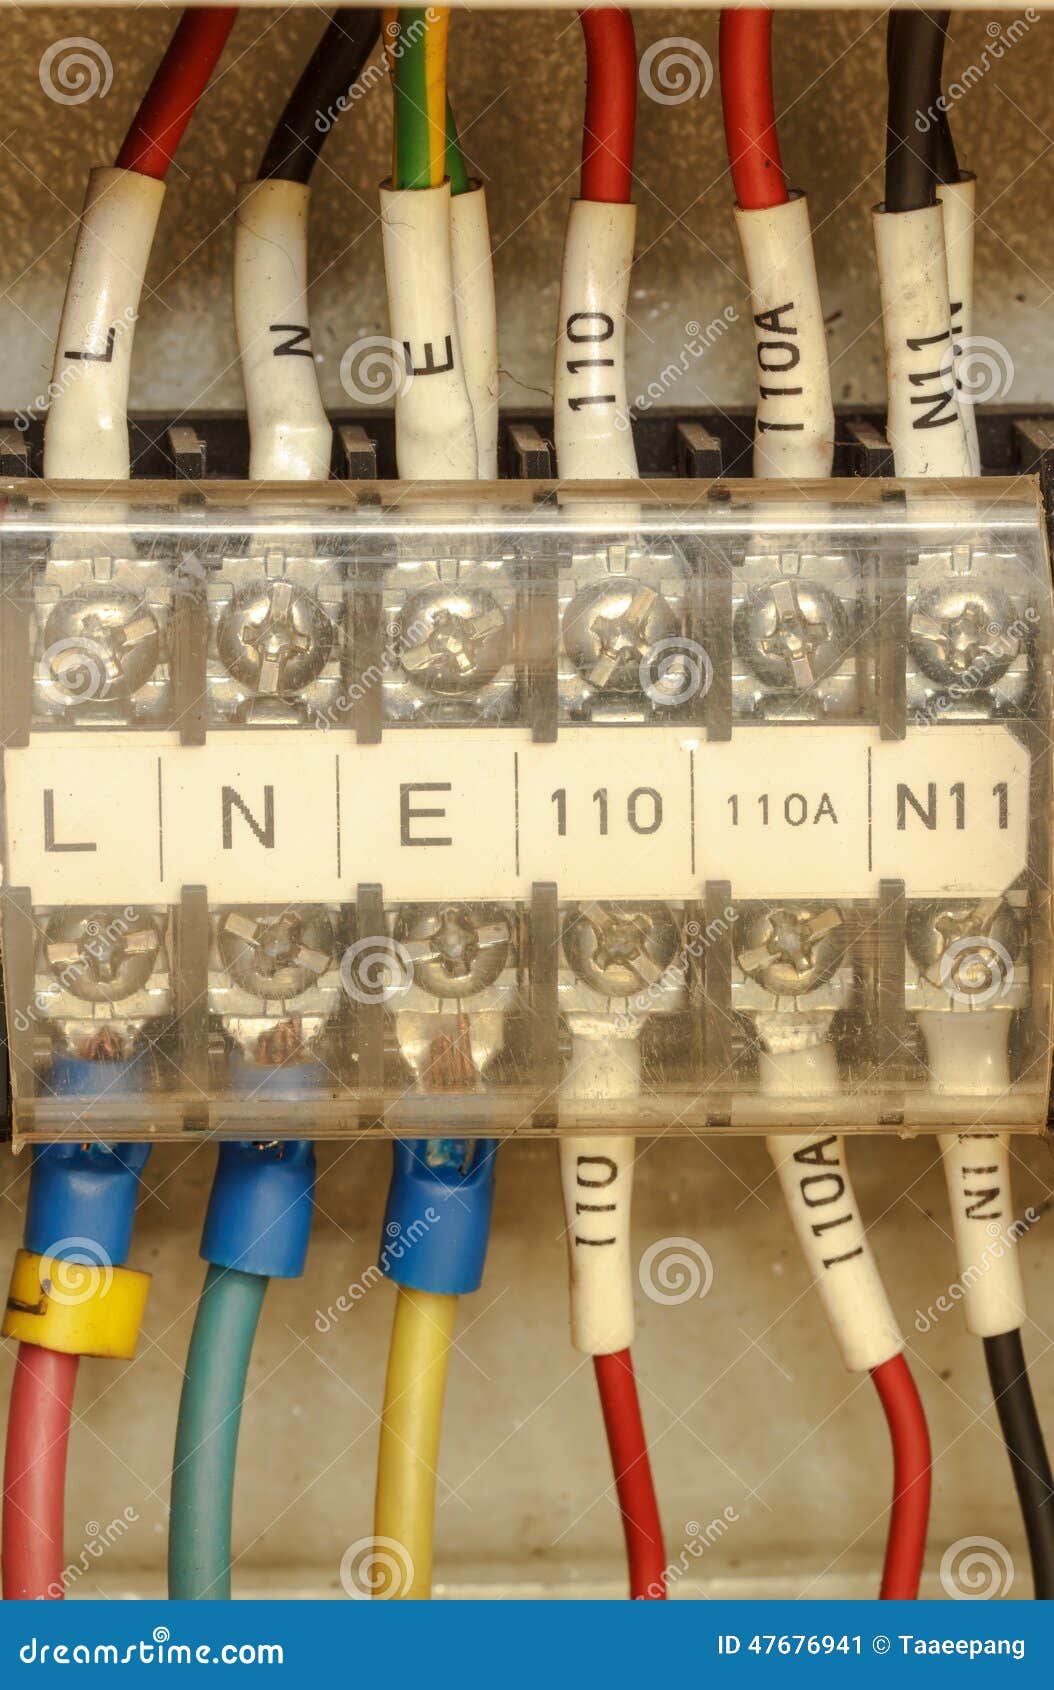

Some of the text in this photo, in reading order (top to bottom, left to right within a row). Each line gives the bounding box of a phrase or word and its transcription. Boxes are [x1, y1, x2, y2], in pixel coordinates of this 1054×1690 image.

[64, 327, 116, 363] L
[269, 324, 314, 358] N
[402, 334, 455, 377] E
[566, 311, 617, 412] 110
[753, 301, 805, 434] 110A
[906, 329, 959, 430] N11
[43, 782, 1010, 853] L N E 110 110A N11
[575, 1155, 618, 1248] 110
[792, 1135, 864, 1270] 110A
